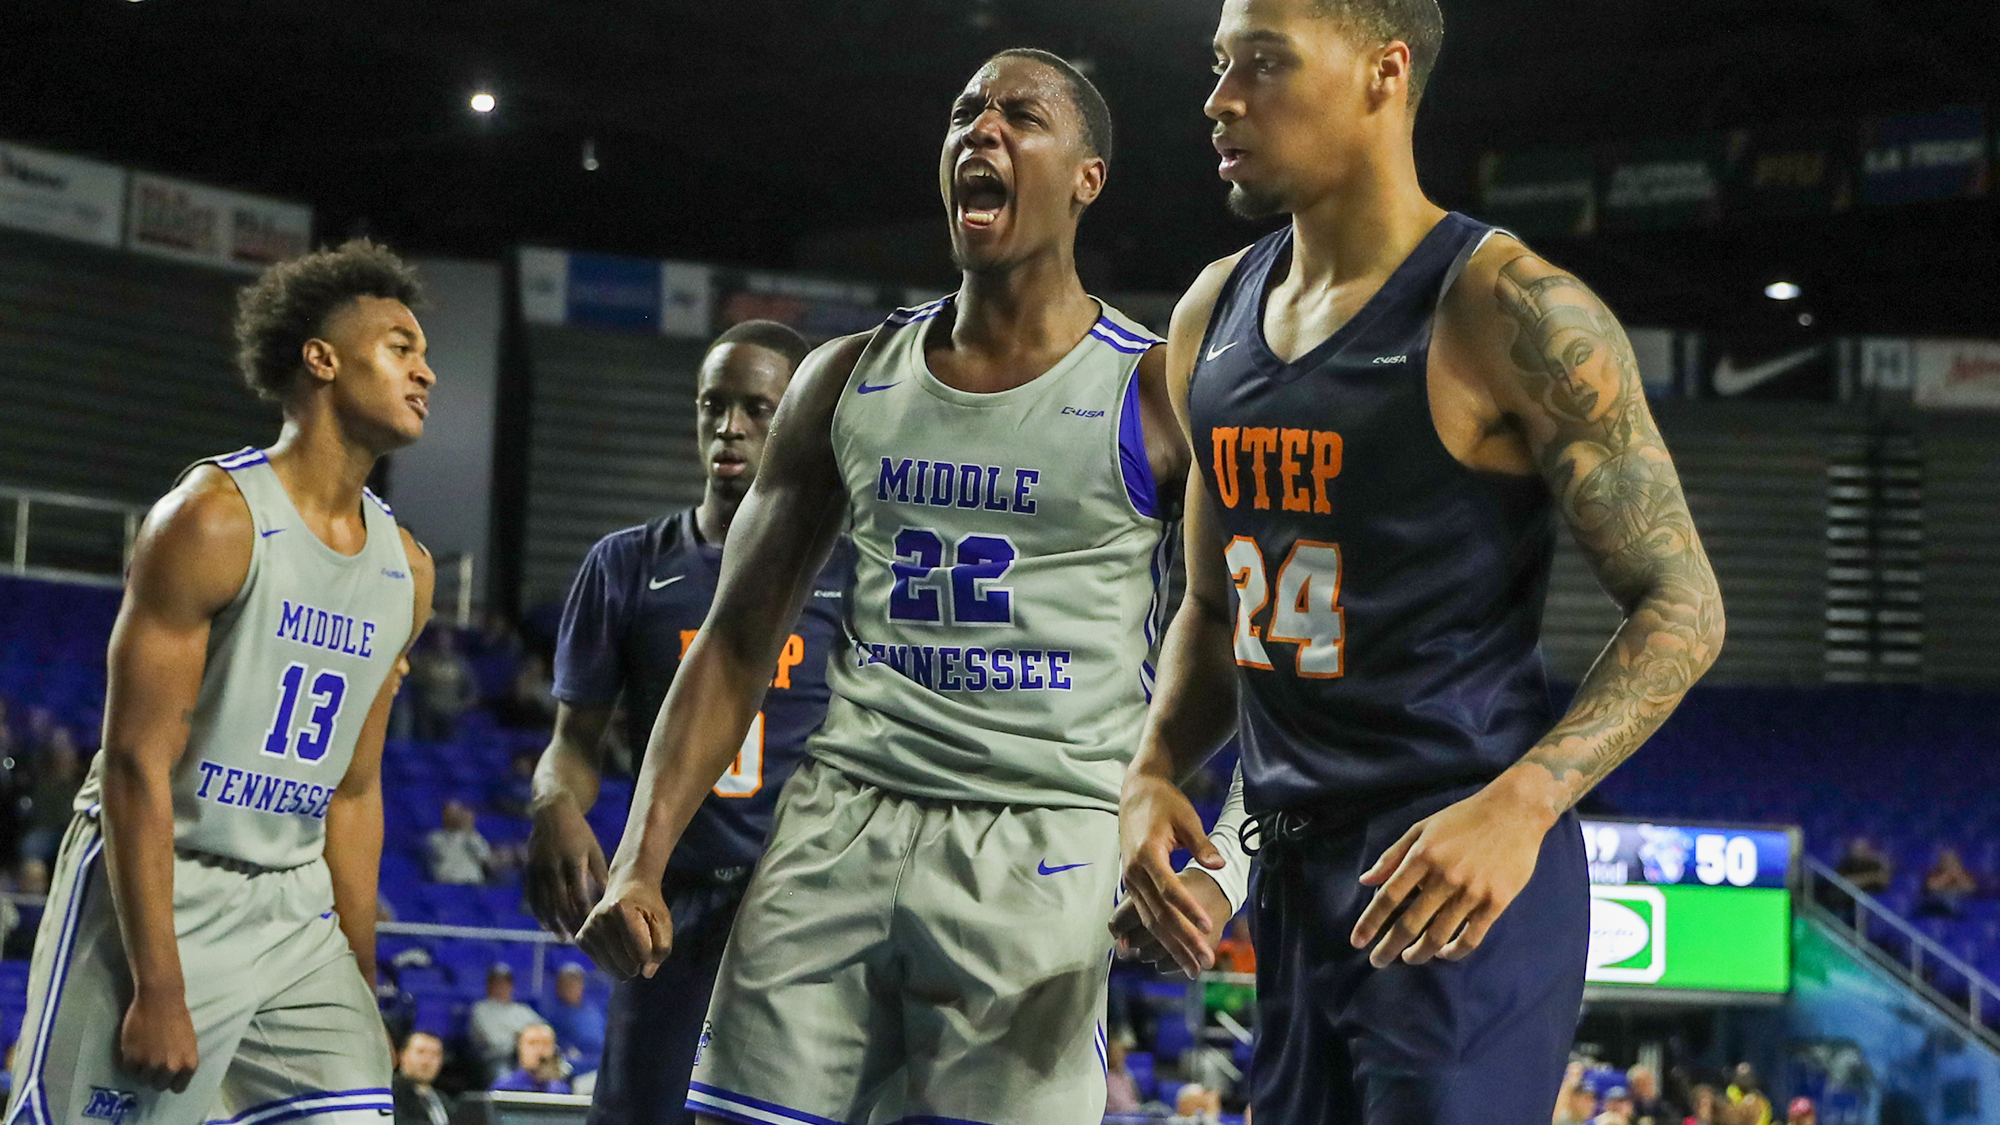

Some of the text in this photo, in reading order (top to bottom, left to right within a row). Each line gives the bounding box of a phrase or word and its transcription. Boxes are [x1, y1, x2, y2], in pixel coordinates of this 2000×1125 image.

[877, 456, 1040, 515] MIDDLE
[1211, 427, 1343, 514] UTEP
[887, 526, 1019, 628] 22
[1224, 535, 1345, 679] 24
[276, 600, 375, 659] MIDDLE
[260, 660, 349, 767] 13
[1695, 834, 1758, 887] 50
